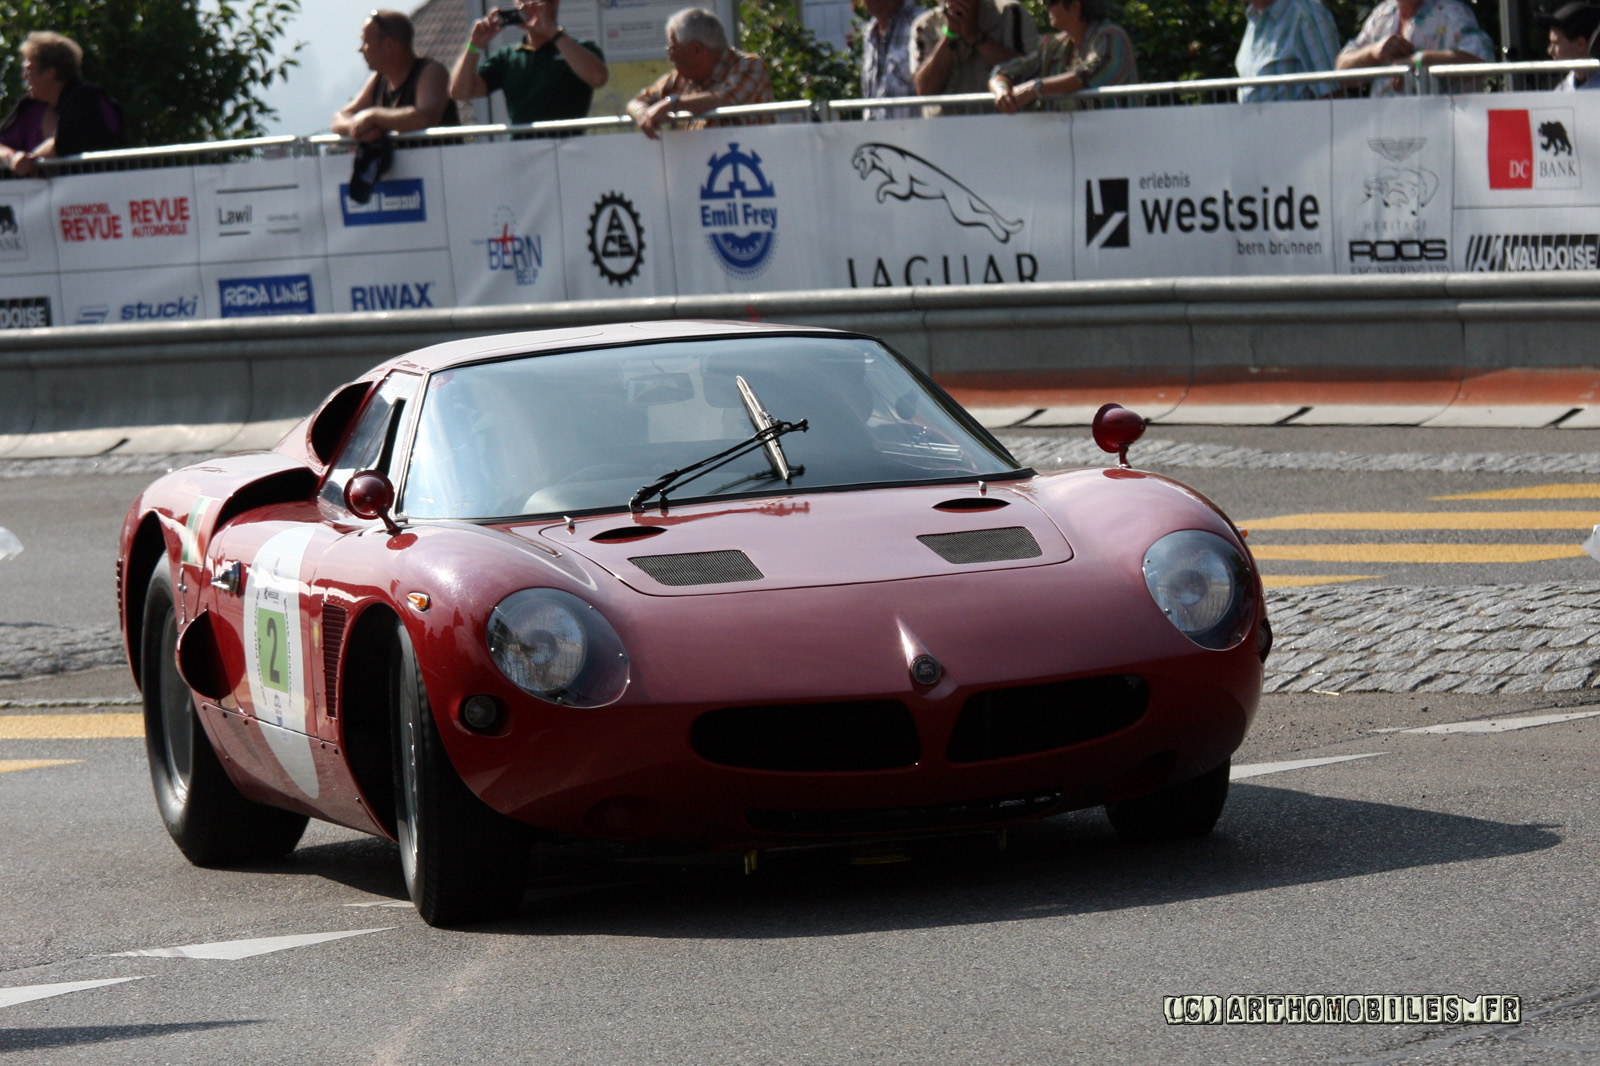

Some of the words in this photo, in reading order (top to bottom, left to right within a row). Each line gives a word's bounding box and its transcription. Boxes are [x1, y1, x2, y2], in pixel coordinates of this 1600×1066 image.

[1139, 172, 1191, 190] erlebnis
[1509, 159, 1530, 179] DC
[1539, 159, 1576, 178] BANK
[129, 197, 190, 223] REVUE
[700, 202, 739, 228] Emil
[742, 202, 777, 230] Frey
[1140, 186, 1320, 234] westside
[61, 215, 122, 242] REVUE
[487, 234, 543, 271] BERN
[1236, 241, 1266, 256] bern
[1349, 239, 1448, 262] ROOS
[120, 295, 199, 320] stucki
[351, 281, 434, 312] RIWAX
[267, 617, 281, 684] 2
